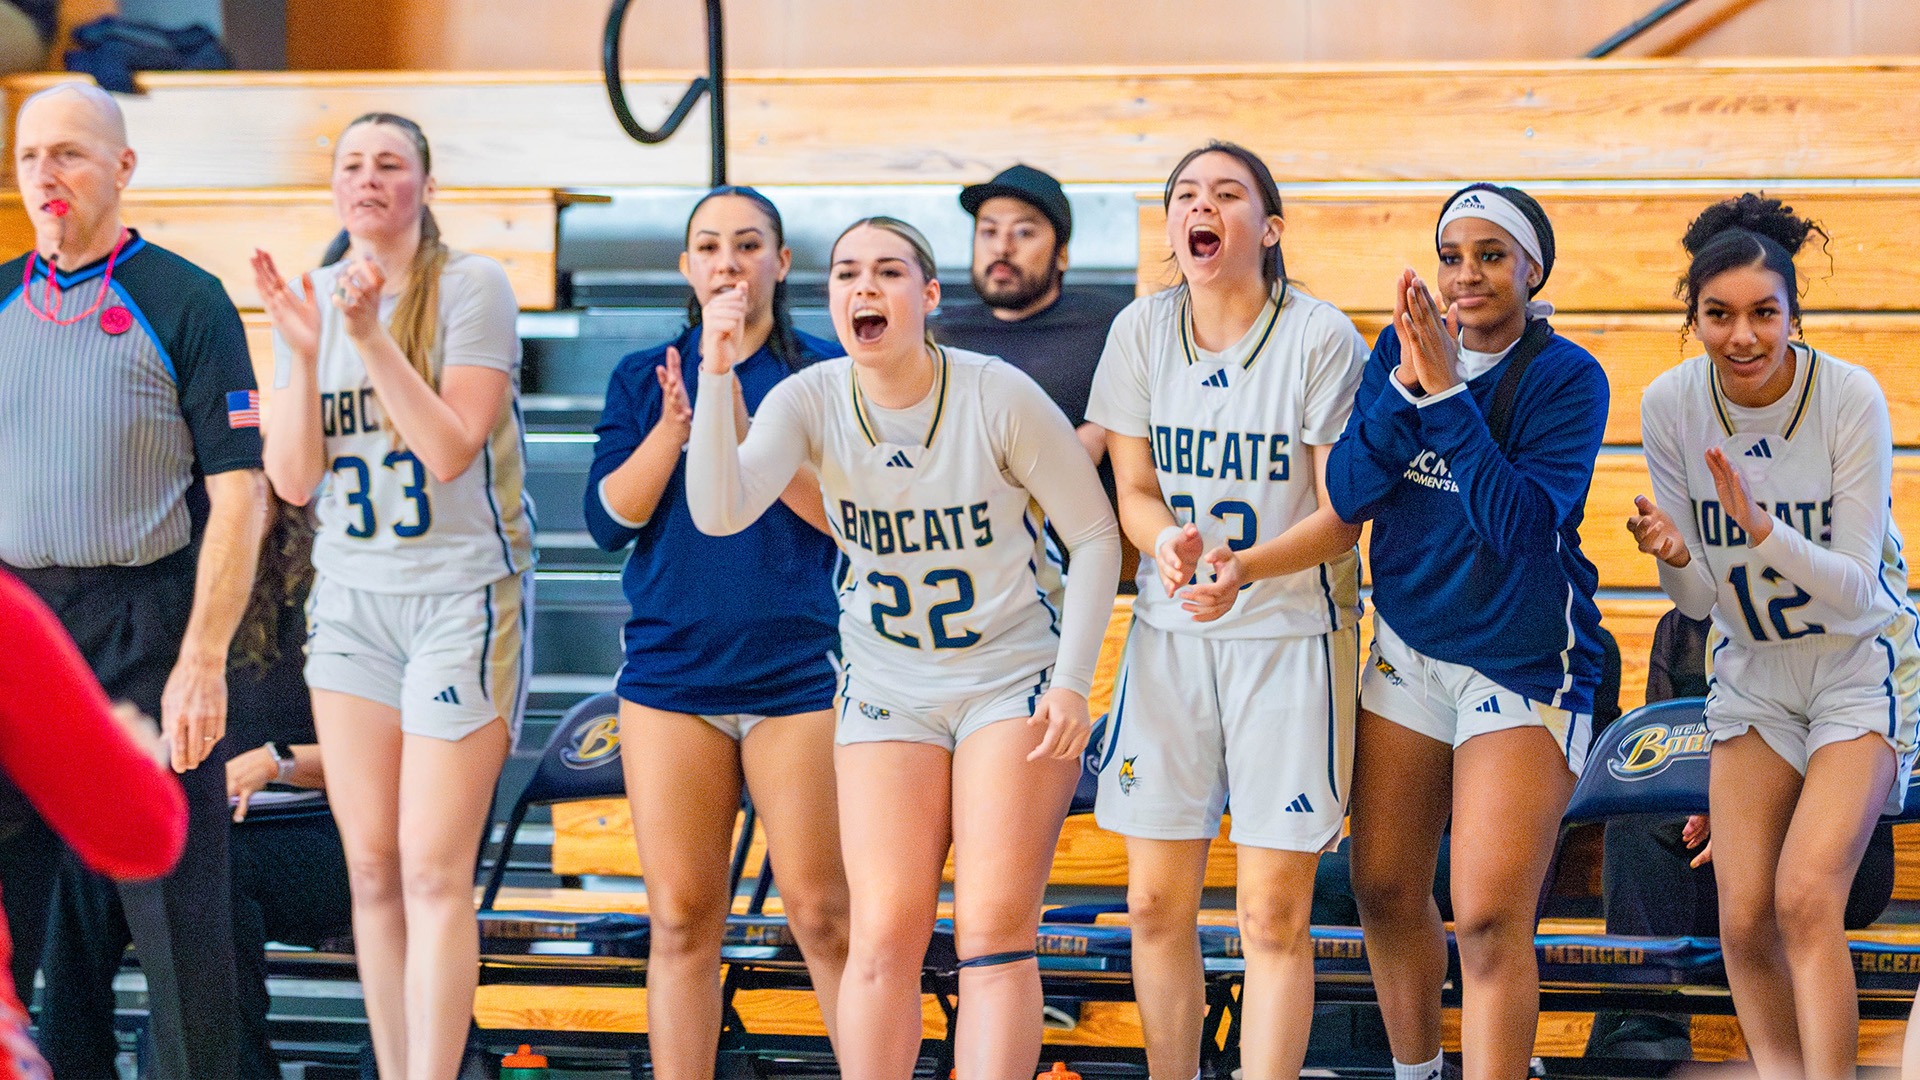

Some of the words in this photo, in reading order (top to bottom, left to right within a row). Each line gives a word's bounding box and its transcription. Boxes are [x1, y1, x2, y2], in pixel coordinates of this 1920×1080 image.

[1149, 425, 1290, 481] OBCATS
[332, 451, 431, 538] 33
[839, 499, 993, 555] BOBCATS
[866, 568, 982, 650] 22
[1728, 565, 1826, 642] 12
